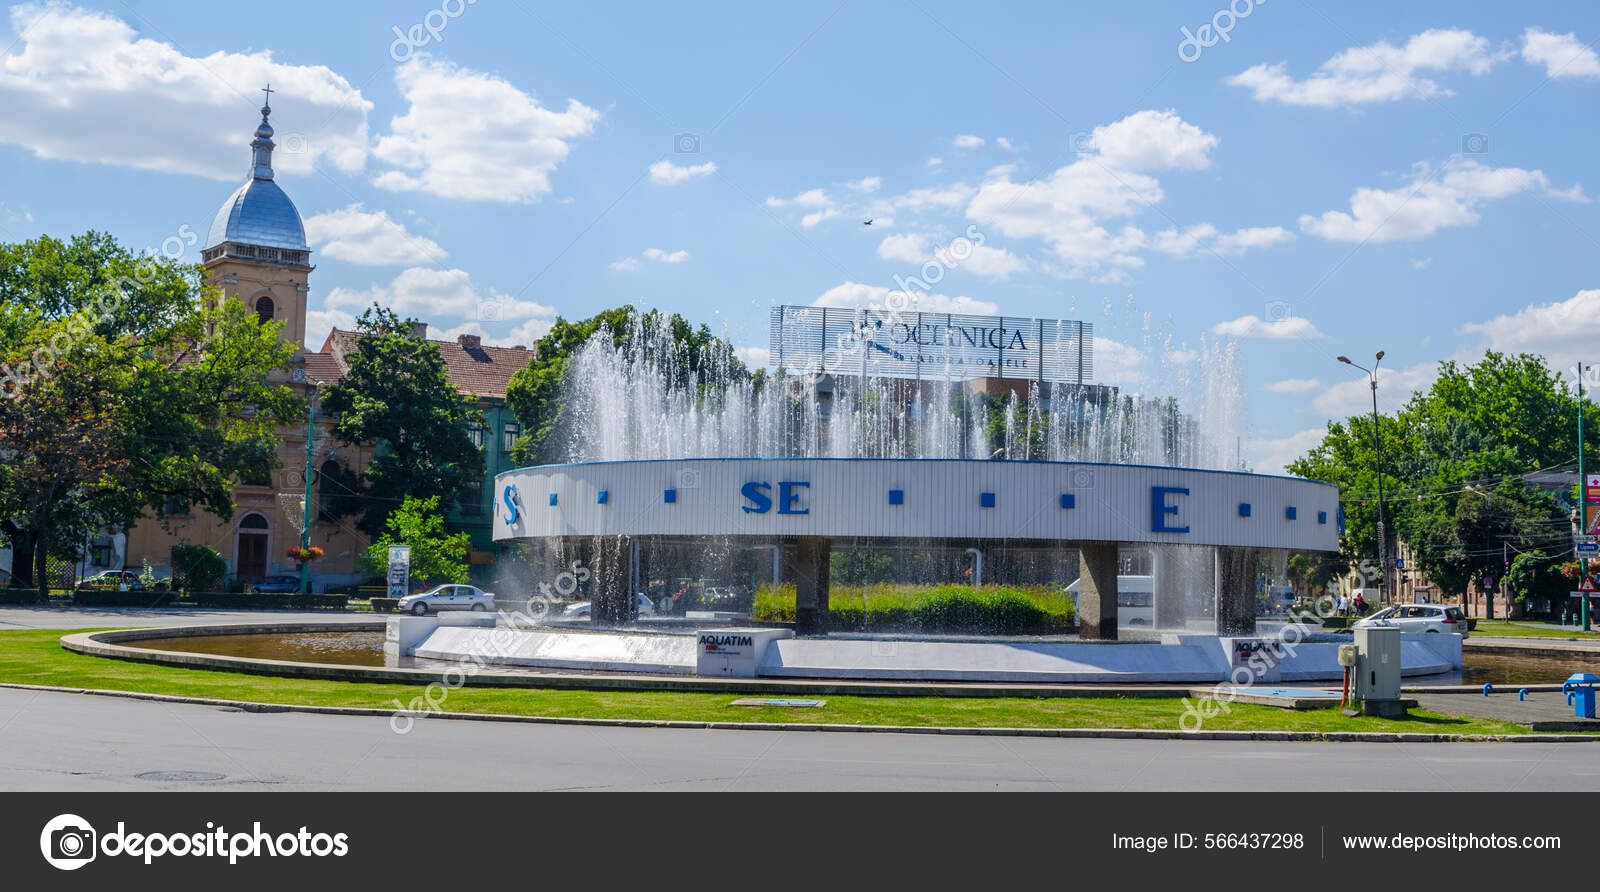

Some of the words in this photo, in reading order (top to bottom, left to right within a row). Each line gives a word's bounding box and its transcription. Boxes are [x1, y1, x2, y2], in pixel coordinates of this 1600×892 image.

[503, 484, 520, 526] S
[741, 481, 811, 515] SE
[1151, 486, 1190, 533] E
[699, 635, 753, 647] AQUATIM
